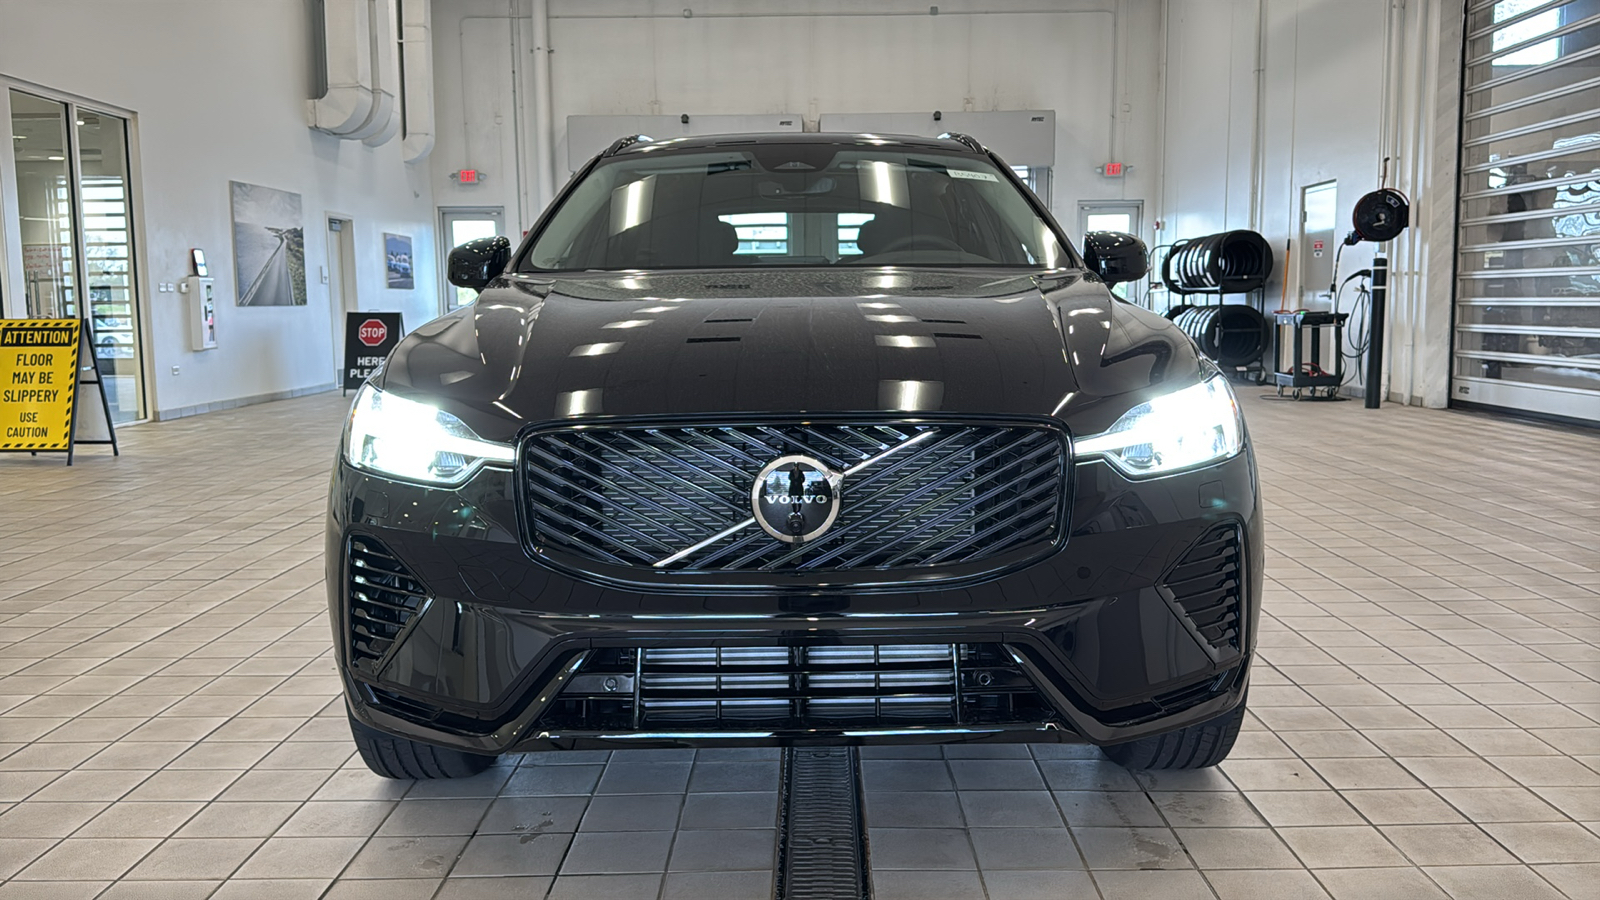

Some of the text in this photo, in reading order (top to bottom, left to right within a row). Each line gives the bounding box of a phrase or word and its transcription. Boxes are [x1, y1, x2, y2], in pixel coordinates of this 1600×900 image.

[1106, 163, 1121, 175] EXIT
[460, 169, 475, 182] EXIT
[4, 330, 70, 344] ATTENTION
[361, 327, 385, 338] STOP
[16, 353, 54, 366] FLOOR
[357, 356, 386, 367] HERE
[12, 371, 54, 384] MAY BE
[350, 368, 373, 379] PLE
[3, 389, 59, 403] SLIPPERY
[20, 412, 38, 423] USE
[6, 427, 49, 438] CAUTION
[764, 494, 828, 505] VOLVO
